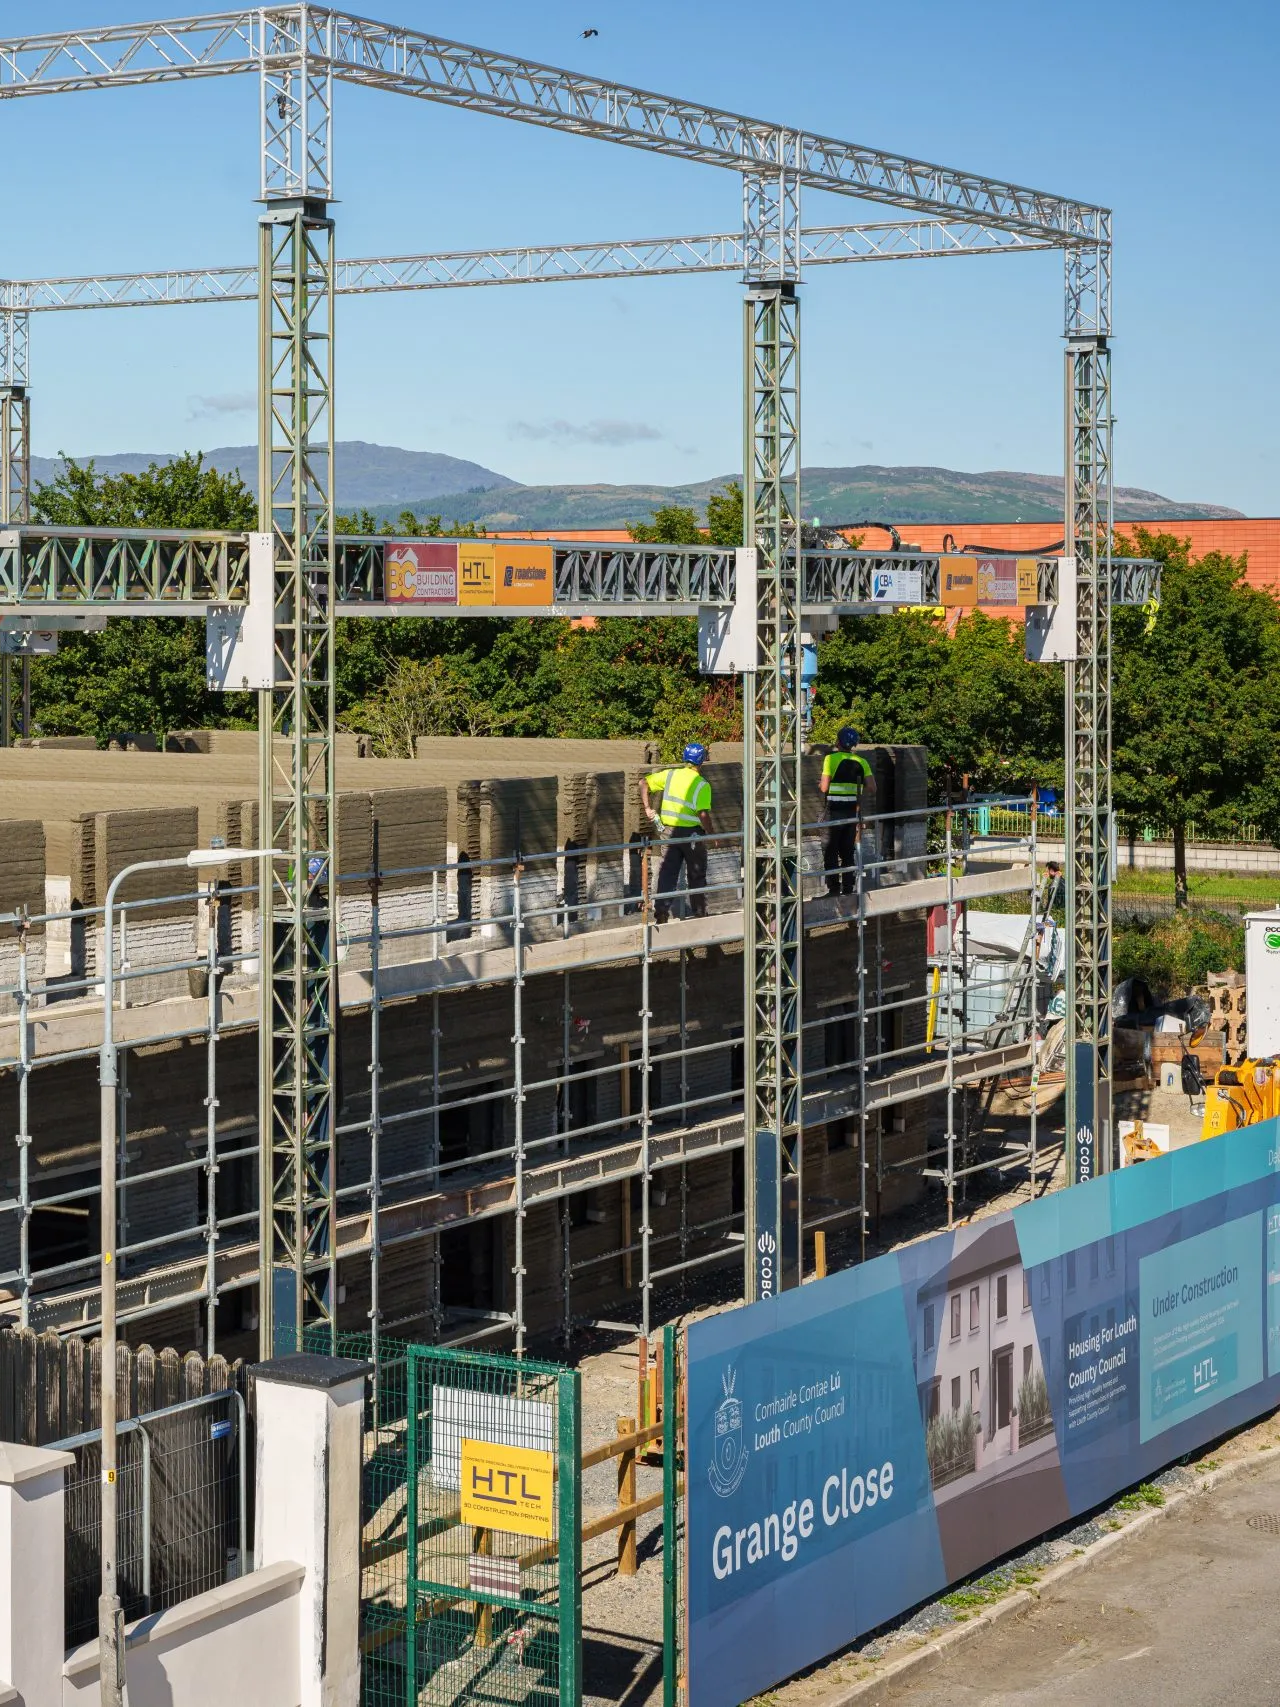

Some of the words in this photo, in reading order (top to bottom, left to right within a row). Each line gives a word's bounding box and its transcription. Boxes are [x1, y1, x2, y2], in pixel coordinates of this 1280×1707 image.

[416, 574, 454, 585] BUILDING
[463, 561, 490, 579] HTL
[880, 574, 893, 587] CBA
[1019, 572, 1036, 586] HTL
[416, 588, 454, 596] CONTRACTORS
[1152, 1290, 1180, 1318] Under
[1181, 1265, 1238, 1305] Construction
[1068, 1333, 1100, 1361] Housing
[1101, 1327, 1114, 1345] For
[1114, 1314, 1137, 1339] Louth
[1068, 1364, 1097, 1389] County
[1098, 1346, 1127, 1376] Council
[1193, 1357, 1218, 1386] HTL
[755, 1389, 797, 1422] Comhairle
[799, 1380, 829, 1404] Contae
[830, 1371, 841, 1392] Lú
[754, 1423, 781, 1451] Louth
[783, 1413, 813, 1438] County
[814, 1396, 845, 1425] Council
[472, 1465, 541, 1500] HTL
[472, 1504, 519, 1517] CONSTRUCTION
[520, 1512, 550, 1522] PRINTING
[520, 1501, 542, 1509] TECH
[712, 1497, 814, 1580] Grange
[821, 1461, 894, 1526] Close
